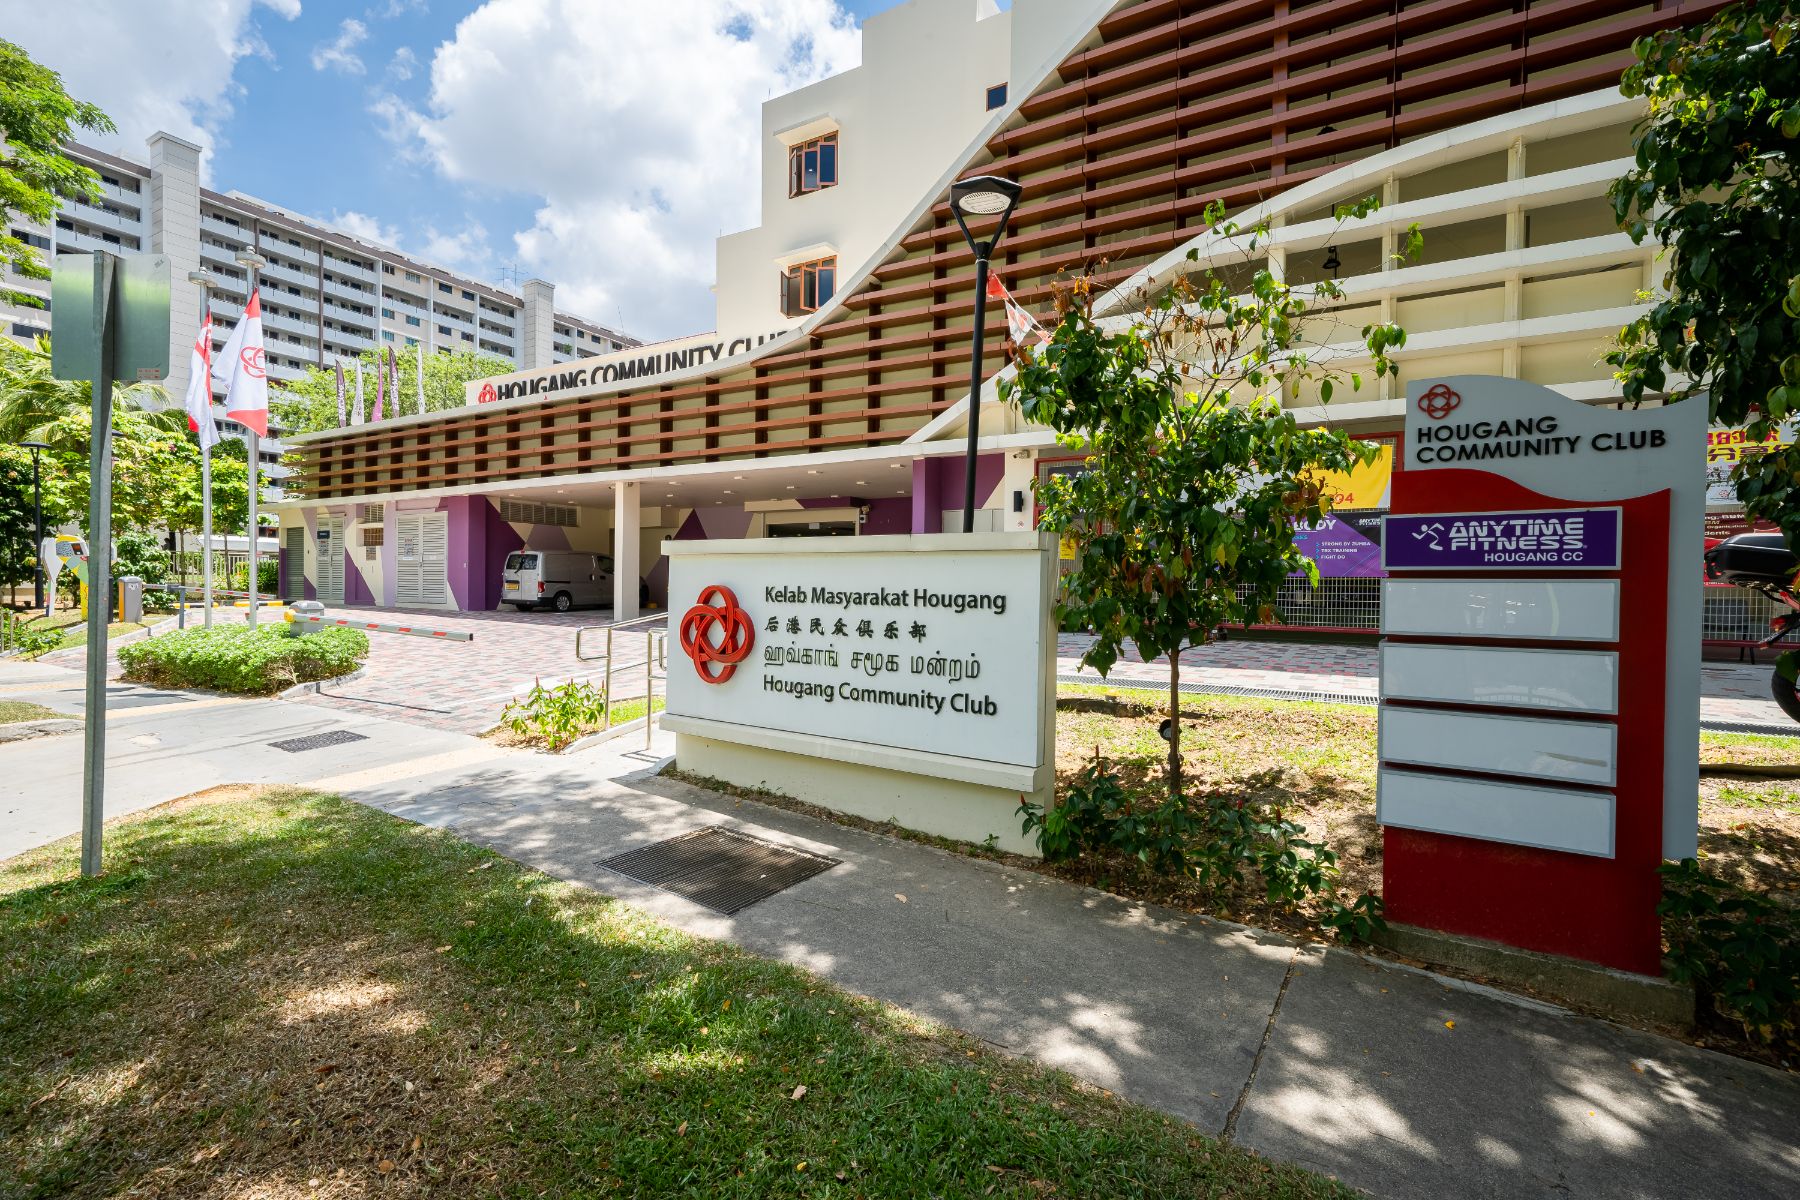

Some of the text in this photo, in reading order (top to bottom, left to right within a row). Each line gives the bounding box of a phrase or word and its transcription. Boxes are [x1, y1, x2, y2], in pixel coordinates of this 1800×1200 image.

[498, 370, 587, 401] HOUGANG
[591, 343, 724, 385] COMMUNITY
[1417, 416, 1558, 443] HOUGANG
[1417, 430, 1667, 464] COMMUNITY CLUB
[1449, 518, 1584, 537] ANYTIME
[1450, 535, 1584, 551] FITNESS
[1484, 551, 1584, 562] HOUGANG CC
[765, 586, 1006, 615] Kelab Masyarakat Hougang
[764, 616, 927, 643] 后港民众俱乐部
[910, 650, 981, 684] மன்றம்
[763, 674, 998, 716] Hougang Community Club
